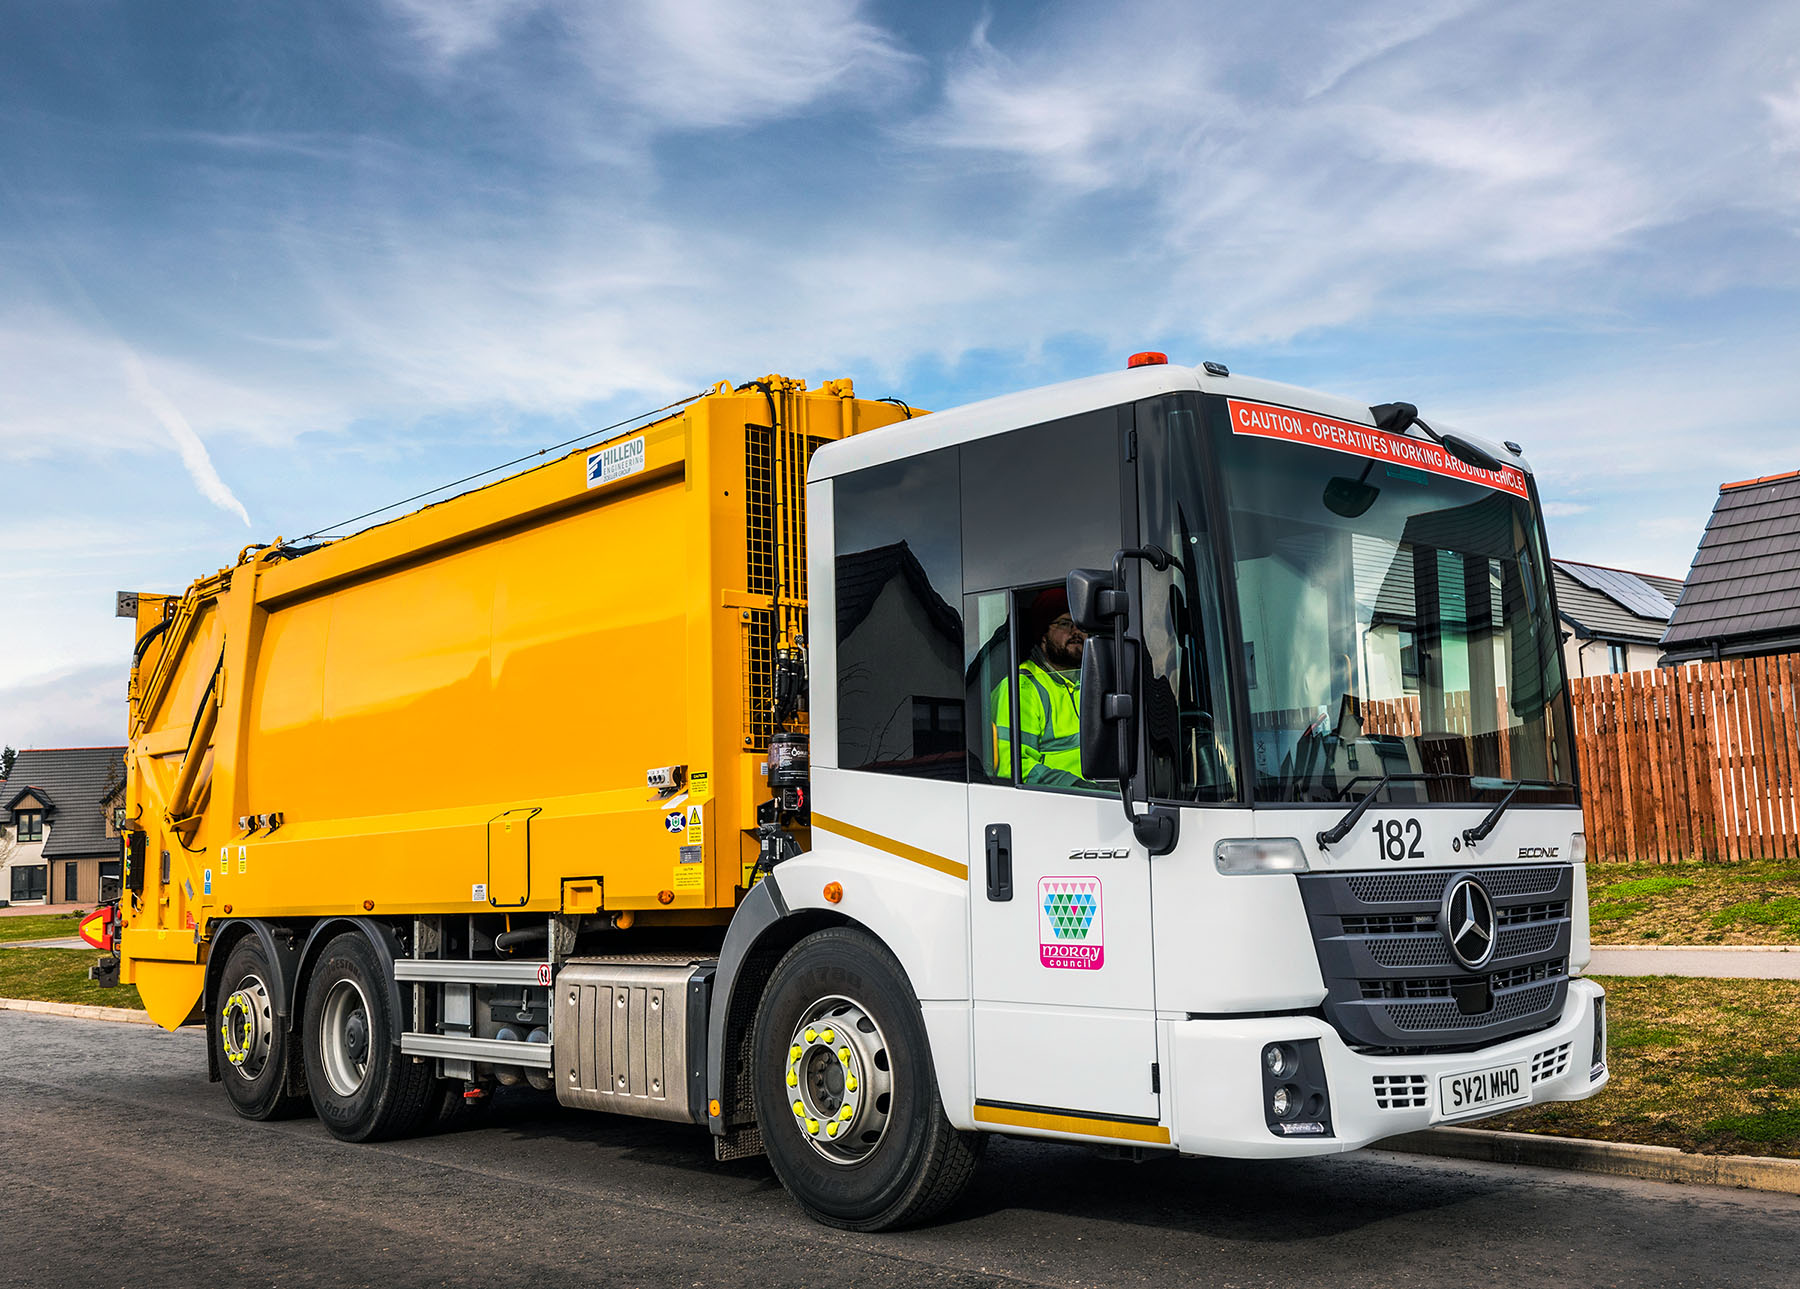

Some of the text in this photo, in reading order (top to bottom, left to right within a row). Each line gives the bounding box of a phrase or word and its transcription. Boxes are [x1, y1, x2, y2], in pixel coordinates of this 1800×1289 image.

[603, 439, 643, 467] HILLEND
[1238, 408, 1303, 436] CAUTION
[1312, 421, 1388, 454] OPERATIVES
[1388, 438, 1443, 467] WORKING
[1444, 454, 1487, 479] AROUND
[1487, 469, 1524, 491] VEHICLE
[603, 455, 644, 476] ENGINEERING
[1371, 818, 1425, 861] 182
[1068, 848, 1131, 860] 2630
[1517, 847, 1559, 859] ECONIC
[1042, 945, 1100, 961] moray
[1049, 959, 1091, 968] council
[1452, 1068, 1520, 1107] SV21 MHO
